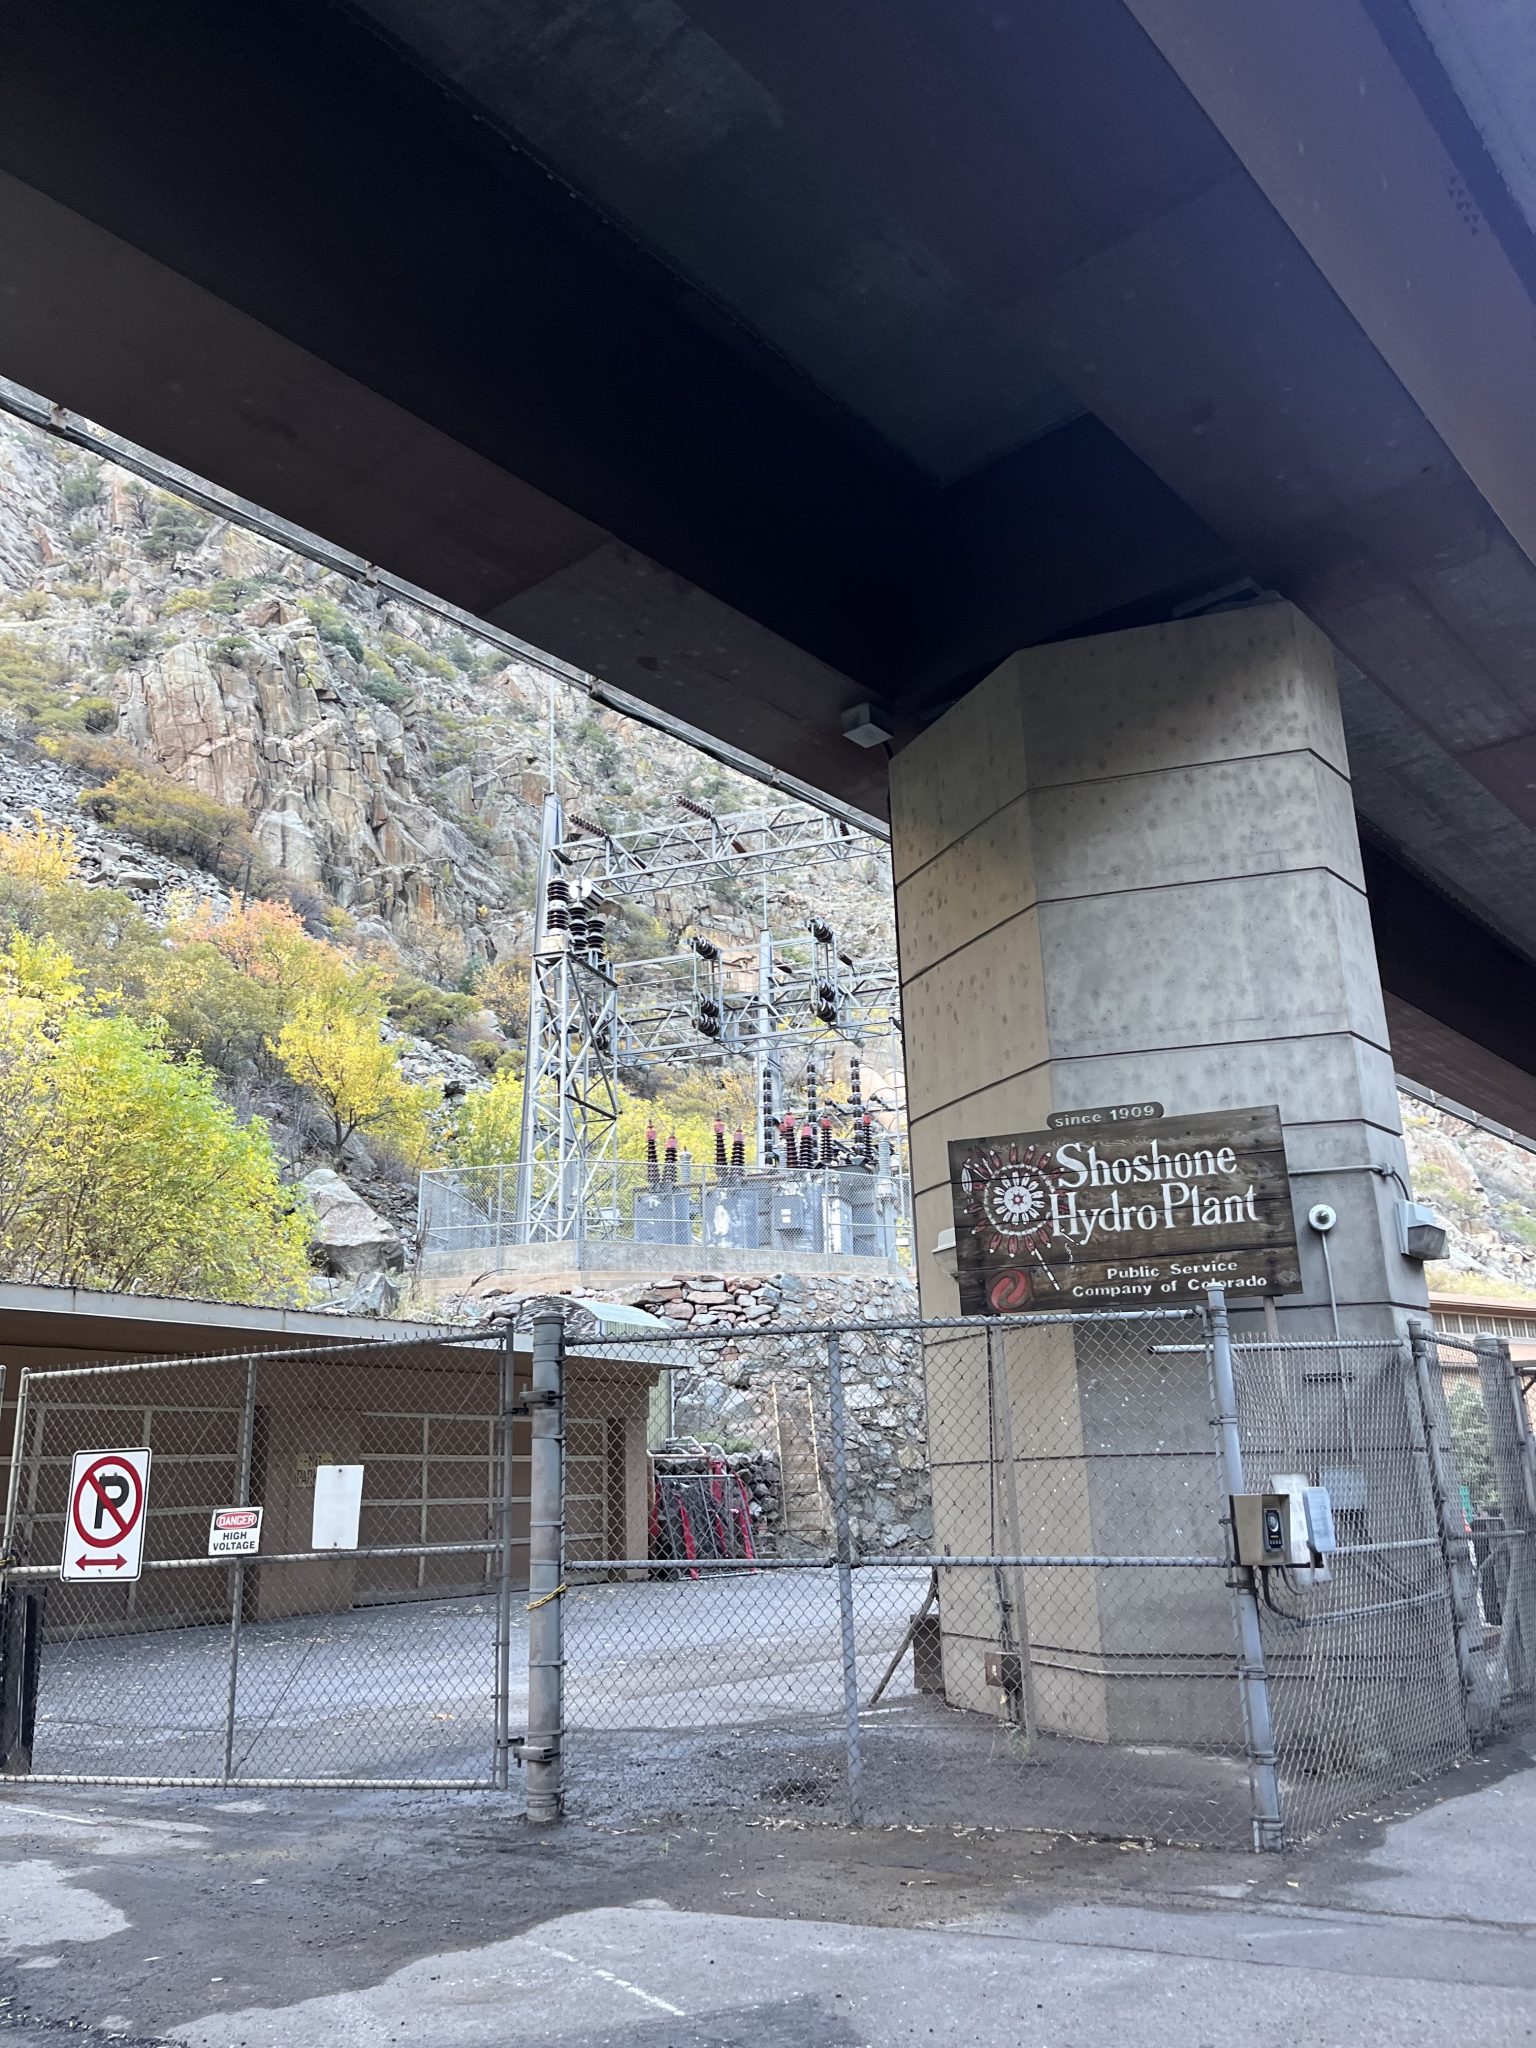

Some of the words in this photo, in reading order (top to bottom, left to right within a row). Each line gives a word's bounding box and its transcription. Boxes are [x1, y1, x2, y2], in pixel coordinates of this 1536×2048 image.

[1055, 1112, 1101, 1127] since
[1110, 1105, 1155, 1121] 1909
[1055, 1139, 1237, 1188] Shoshone
[1049, 1190, 1158, 1245] Hydro
[1160, 1183, 1260, 1230] Plant
[1107, 1266, 1160, 1279] Public
[1170, 1261, 1238, 1275] Service
[1072, 1284, 1152, 1298] Company
[1161, 1280, 1178, 1293] of
[219, 1513, 256, 1527] DANGER
[222, 1531, 247, 1541] HIGH
[213, 1541, 256, 1551] VOLTAGE
